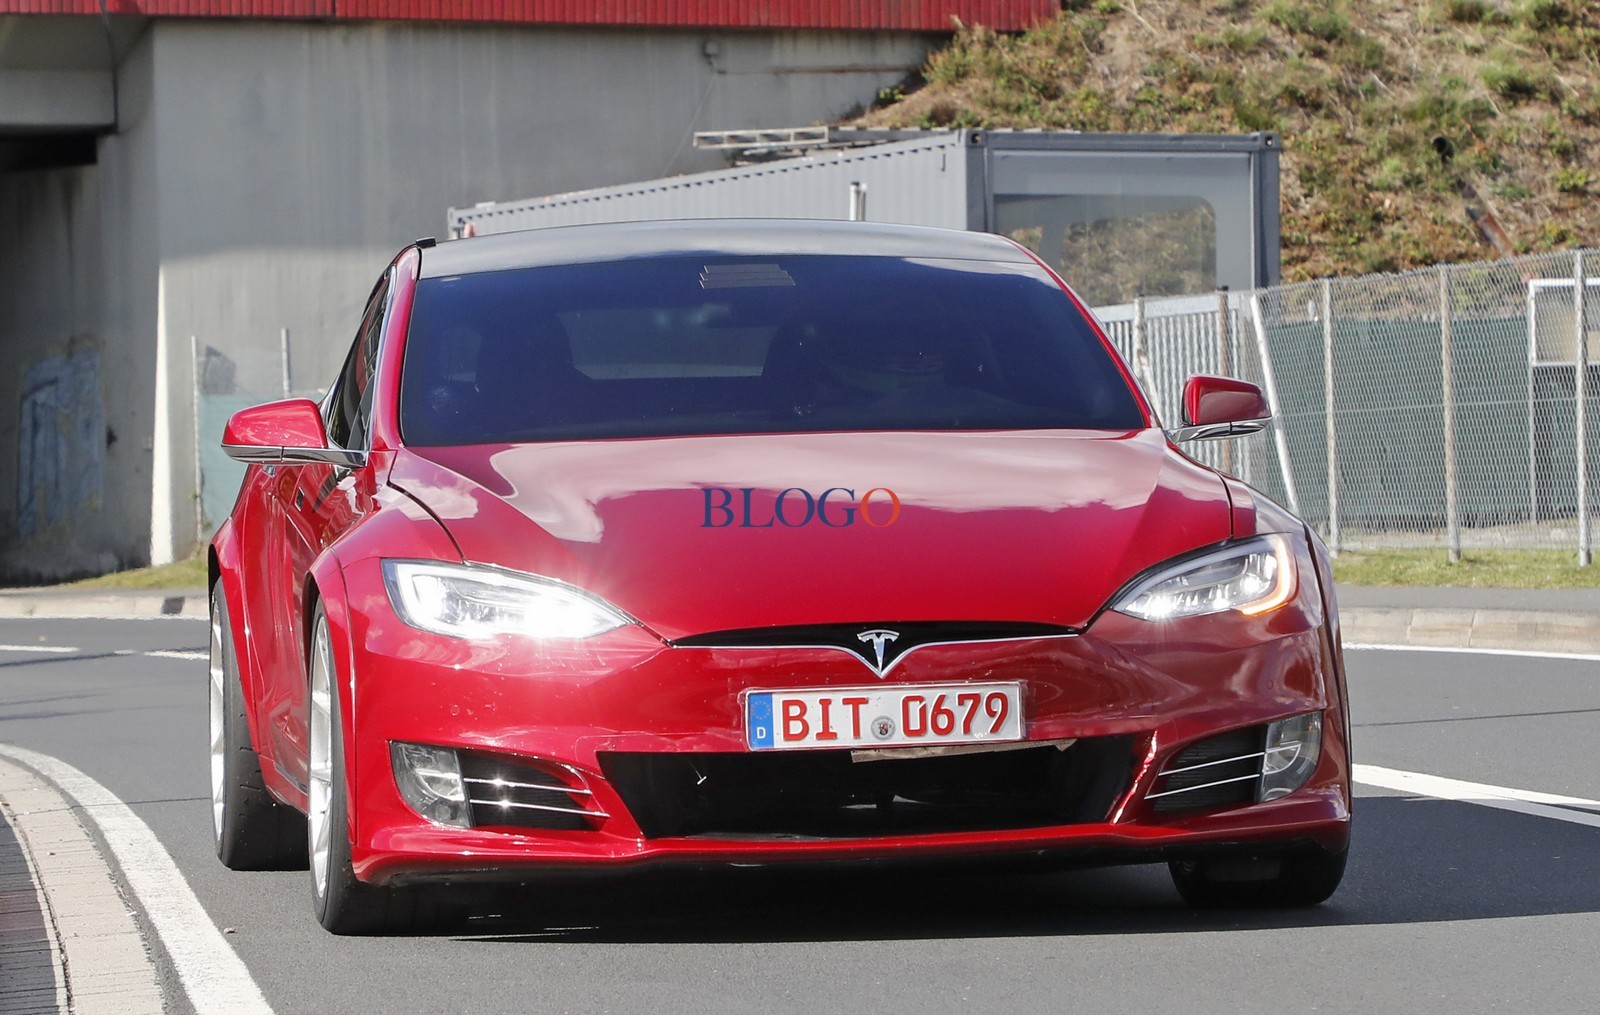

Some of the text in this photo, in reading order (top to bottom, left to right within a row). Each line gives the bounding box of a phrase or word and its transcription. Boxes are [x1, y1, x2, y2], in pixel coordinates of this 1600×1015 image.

[781, 691, 1009, 741] BIT 0679
[756, 726, 766, 739] D
